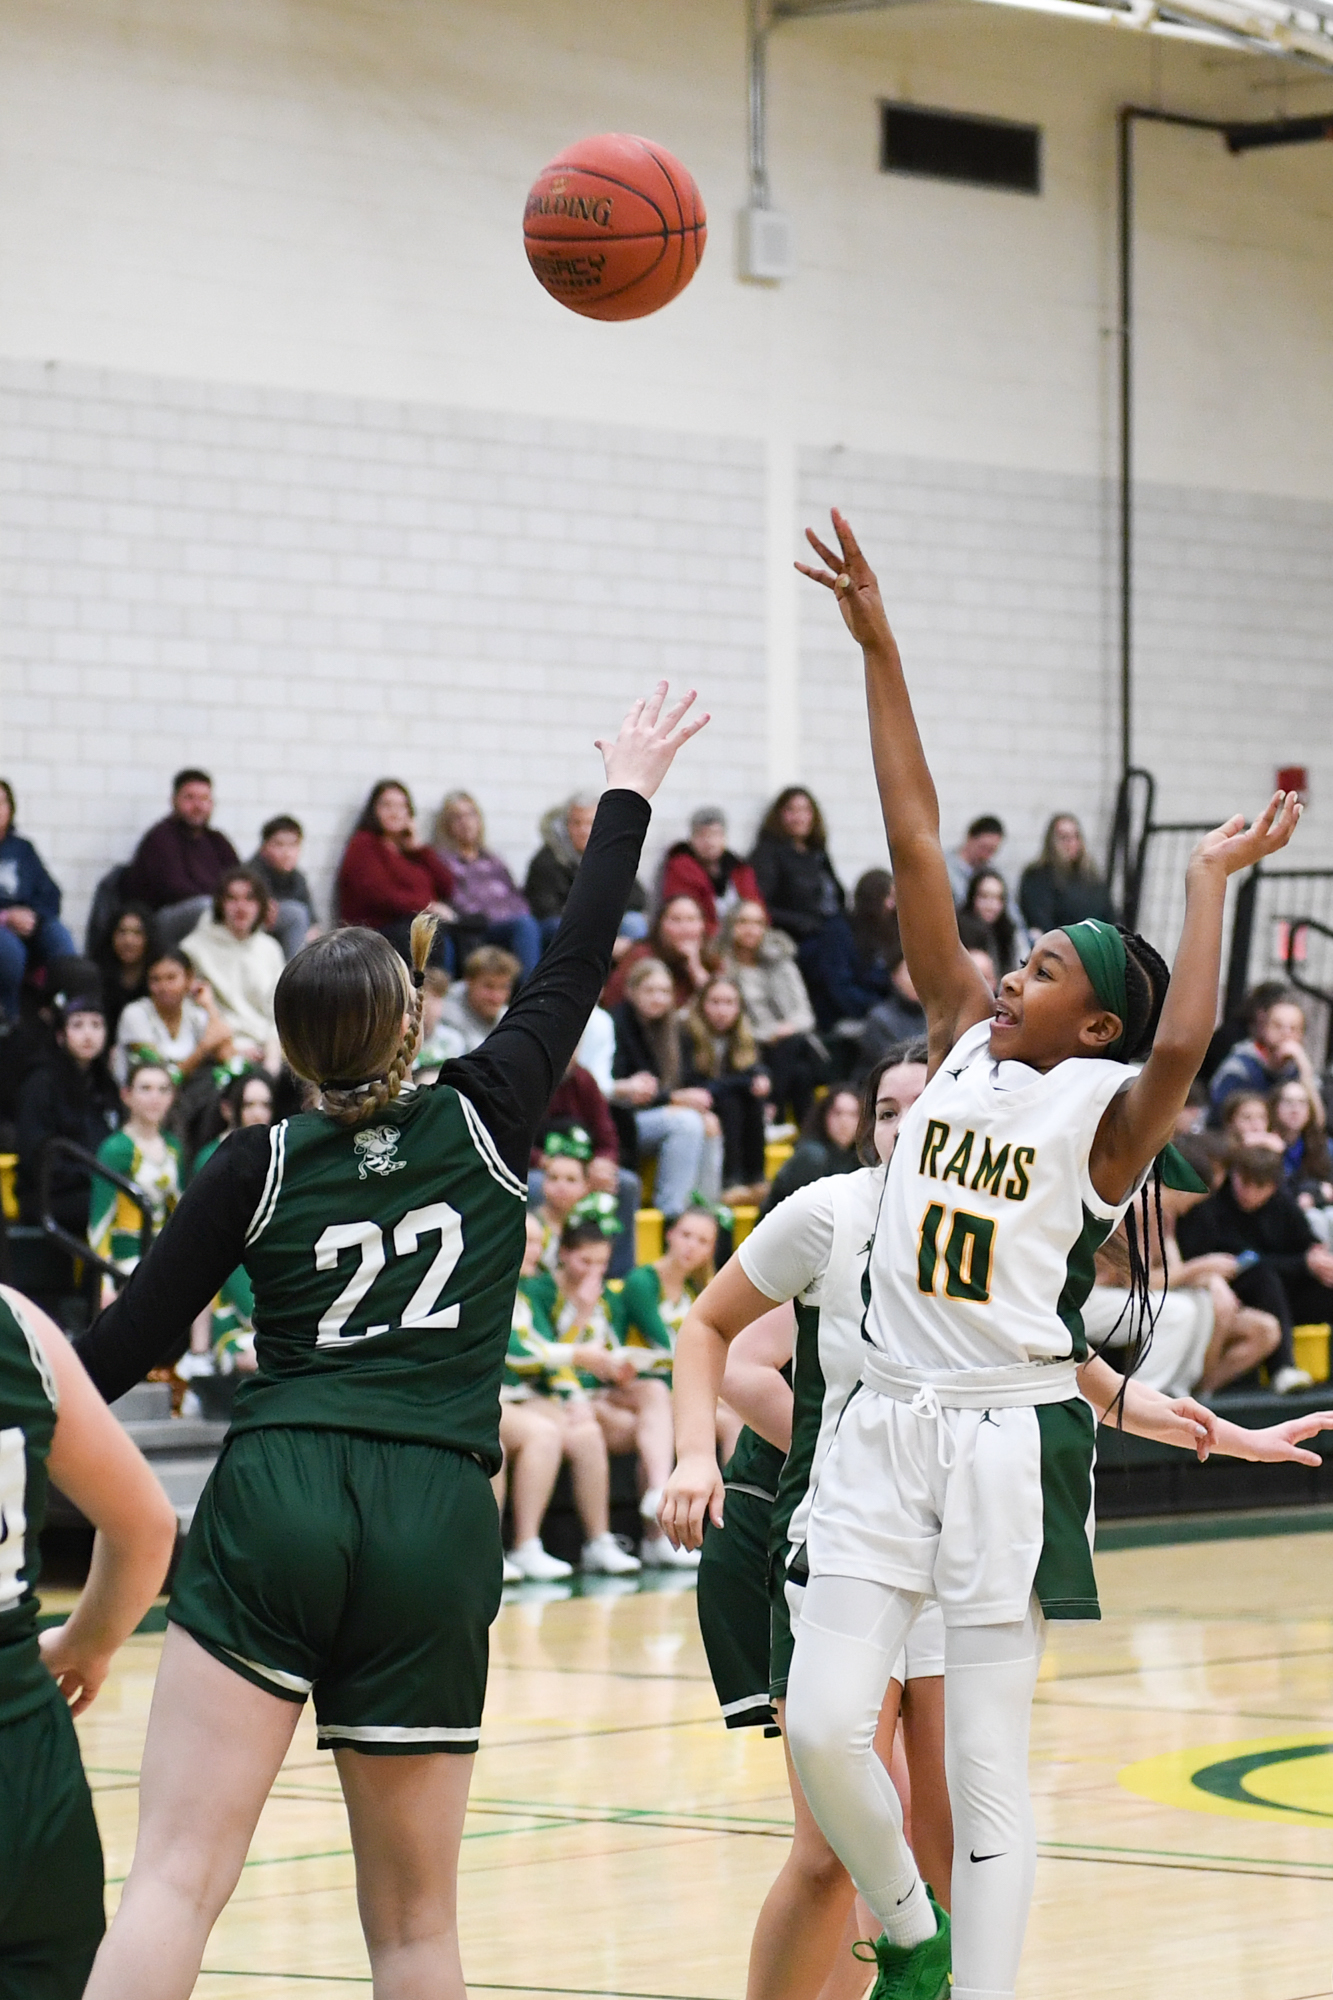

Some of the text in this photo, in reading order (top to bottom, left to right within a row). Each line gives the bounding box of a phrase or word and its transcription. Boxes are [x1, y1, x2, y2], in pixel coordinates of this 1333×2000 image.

[918, 1117, 1036, 1201] RAMS
[314, 1201, 464, 1349] 22
[916, 1200, 999, 1305] 10
